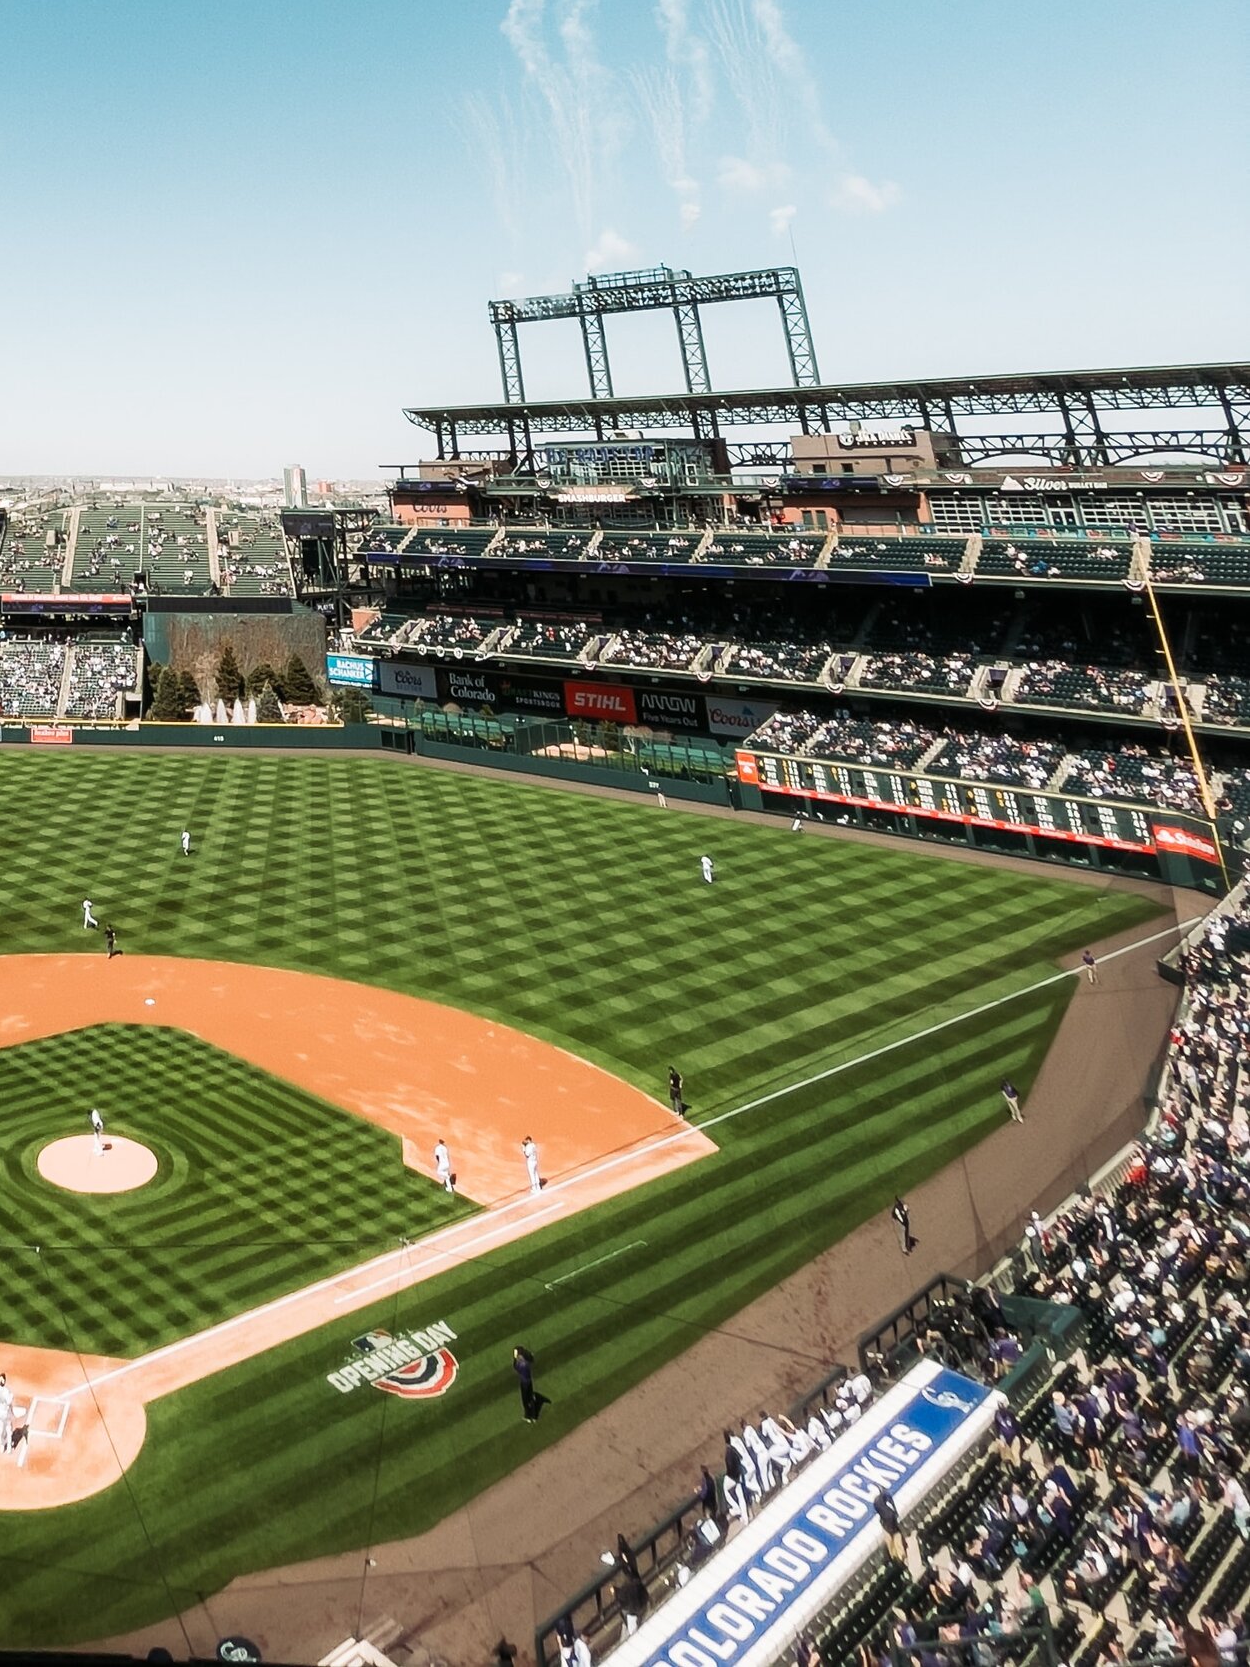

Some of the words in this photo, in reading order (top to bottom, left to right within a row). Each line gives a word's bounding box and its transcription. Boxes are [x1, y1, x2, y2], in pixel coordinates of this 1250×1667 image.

[1024, 477, 1067, 491] Silver
[558, 494, 626, 502] SMASHBURGER
[412, 501, 448, 514] Coors
[394, 669, 422, 685] Coors
[449, 673, 473, 685] Bank
[475, 675, 485, 687] of
[450, 685, 496, 702] Colorado
[515, 696, 561, 708] SPORTSBOOK
[574, 692, 626, 711] STIHL
[683, 717, 698, 727] Out
[710, 708, 750, 727] Coors
[326, 1339, 422, 1394] OPENING
[411, 1320, 458, 1352] DAY
[651, 1527, 829, 1667] OLORADO
[805, 1423, 933, 1537] ROCKIES
